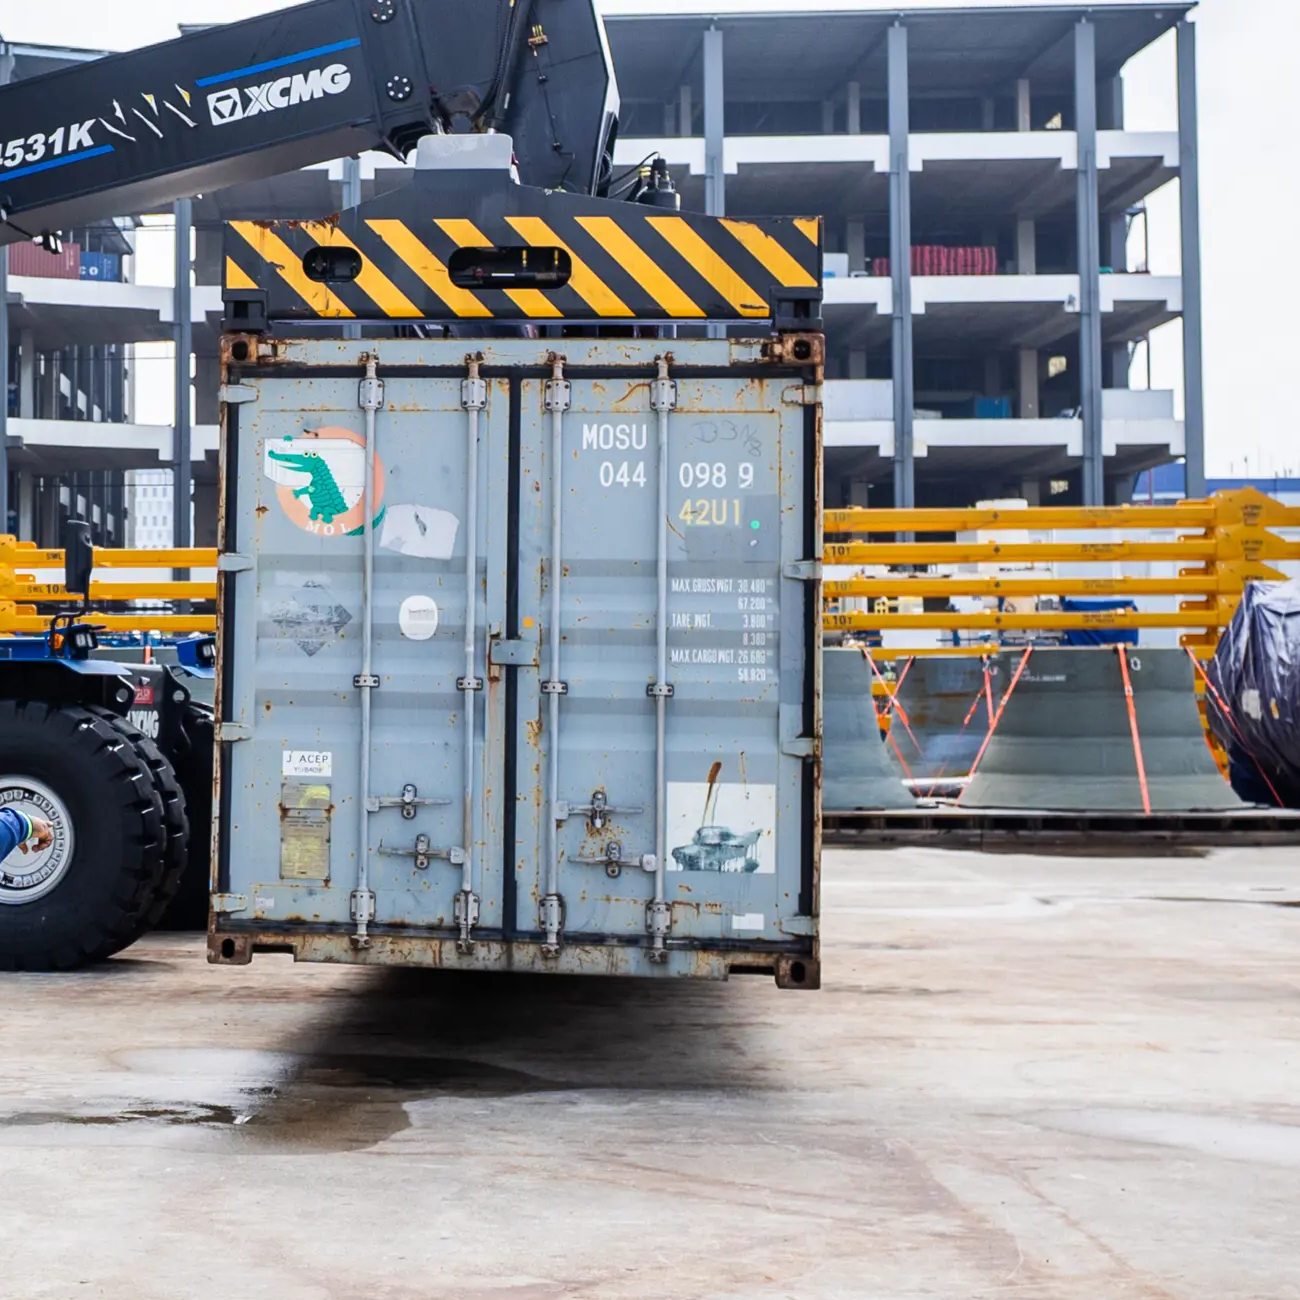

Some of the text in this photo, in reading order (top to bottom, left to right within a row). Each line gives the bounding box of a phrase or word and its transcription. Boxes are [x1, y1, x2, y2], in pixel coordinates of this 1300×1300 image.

[243, 63, 351, 118] XCMG
[582, 423, 647, 450] MOSU
[599, 461, 754, 488] 044 098 9
[679, 499, 740, 526] 42U1
[305, 520, 350, 535] MOL
[672, 613, 691, 627] TARE
[299, 755, 329, 764] ACEP
